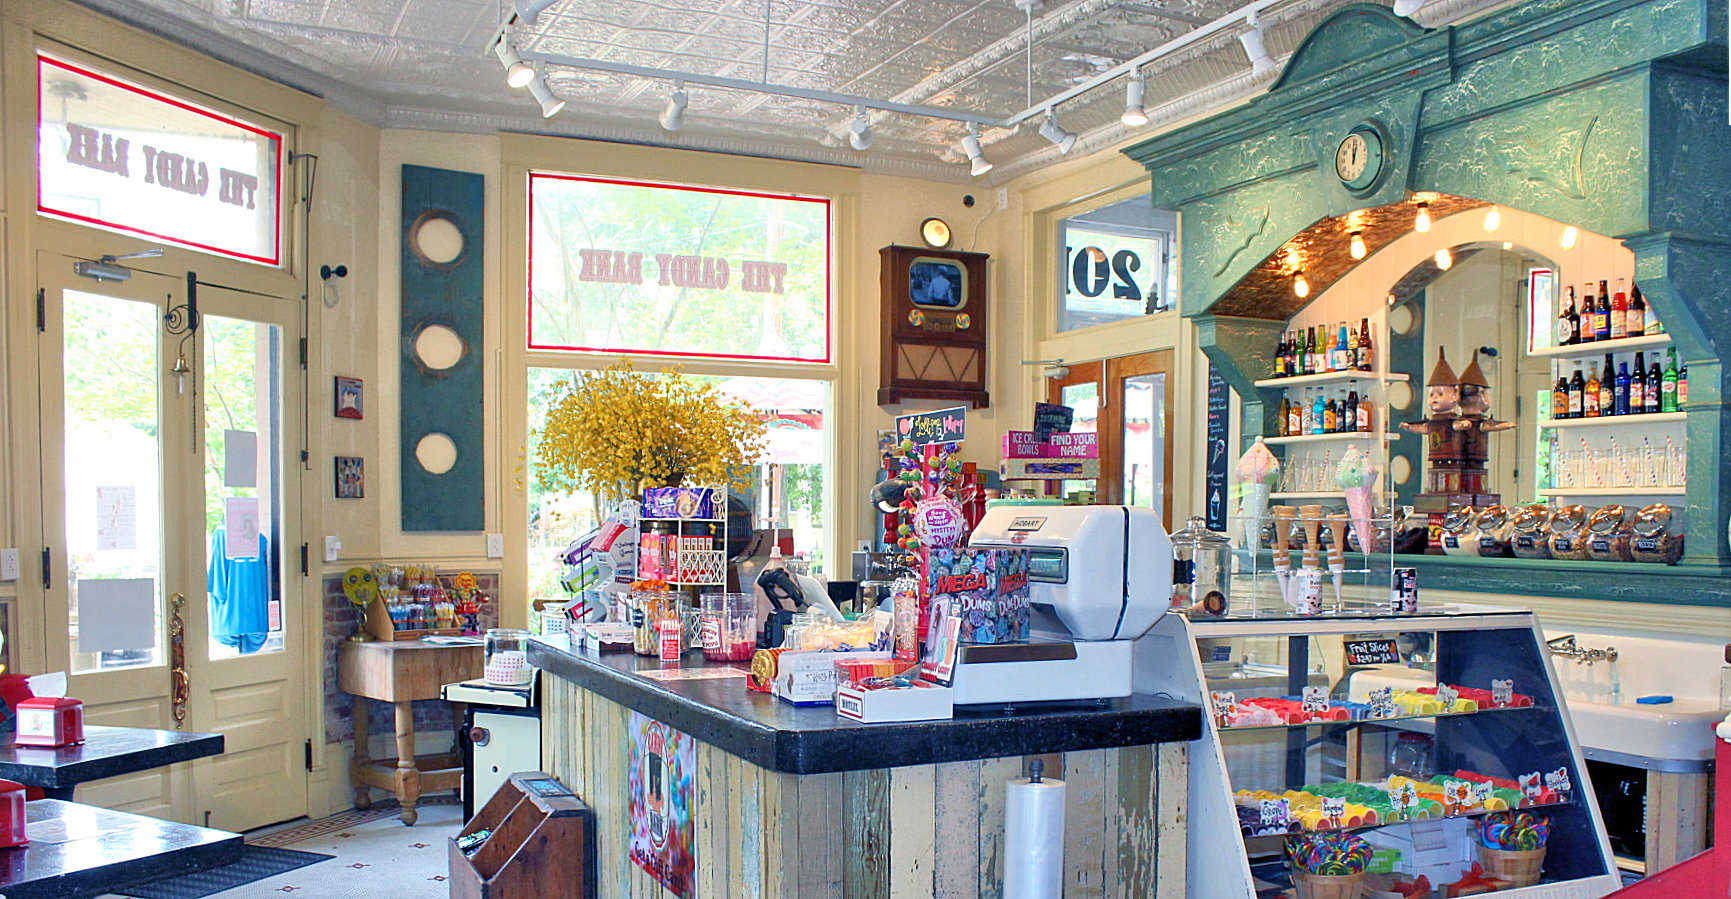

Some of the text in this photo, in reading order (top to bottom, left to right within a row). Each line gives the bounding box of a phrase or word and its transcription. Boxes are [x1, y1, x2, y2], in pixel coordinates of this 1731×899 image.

[1012, 432, 1023, 444] ICE
[1051, 433, 1095, 446] FIND YOUR
[1017, 444, 1039, 456] BOWLS
[1060, 445, 1087, 456] NAME
[936, 573, 987, 595] MEGA
[998, 572, 1028, 595] MEGA
[1349, 641, 1390, 655] Fruit Slices
[1262, 805, 1284, 818] Grape
